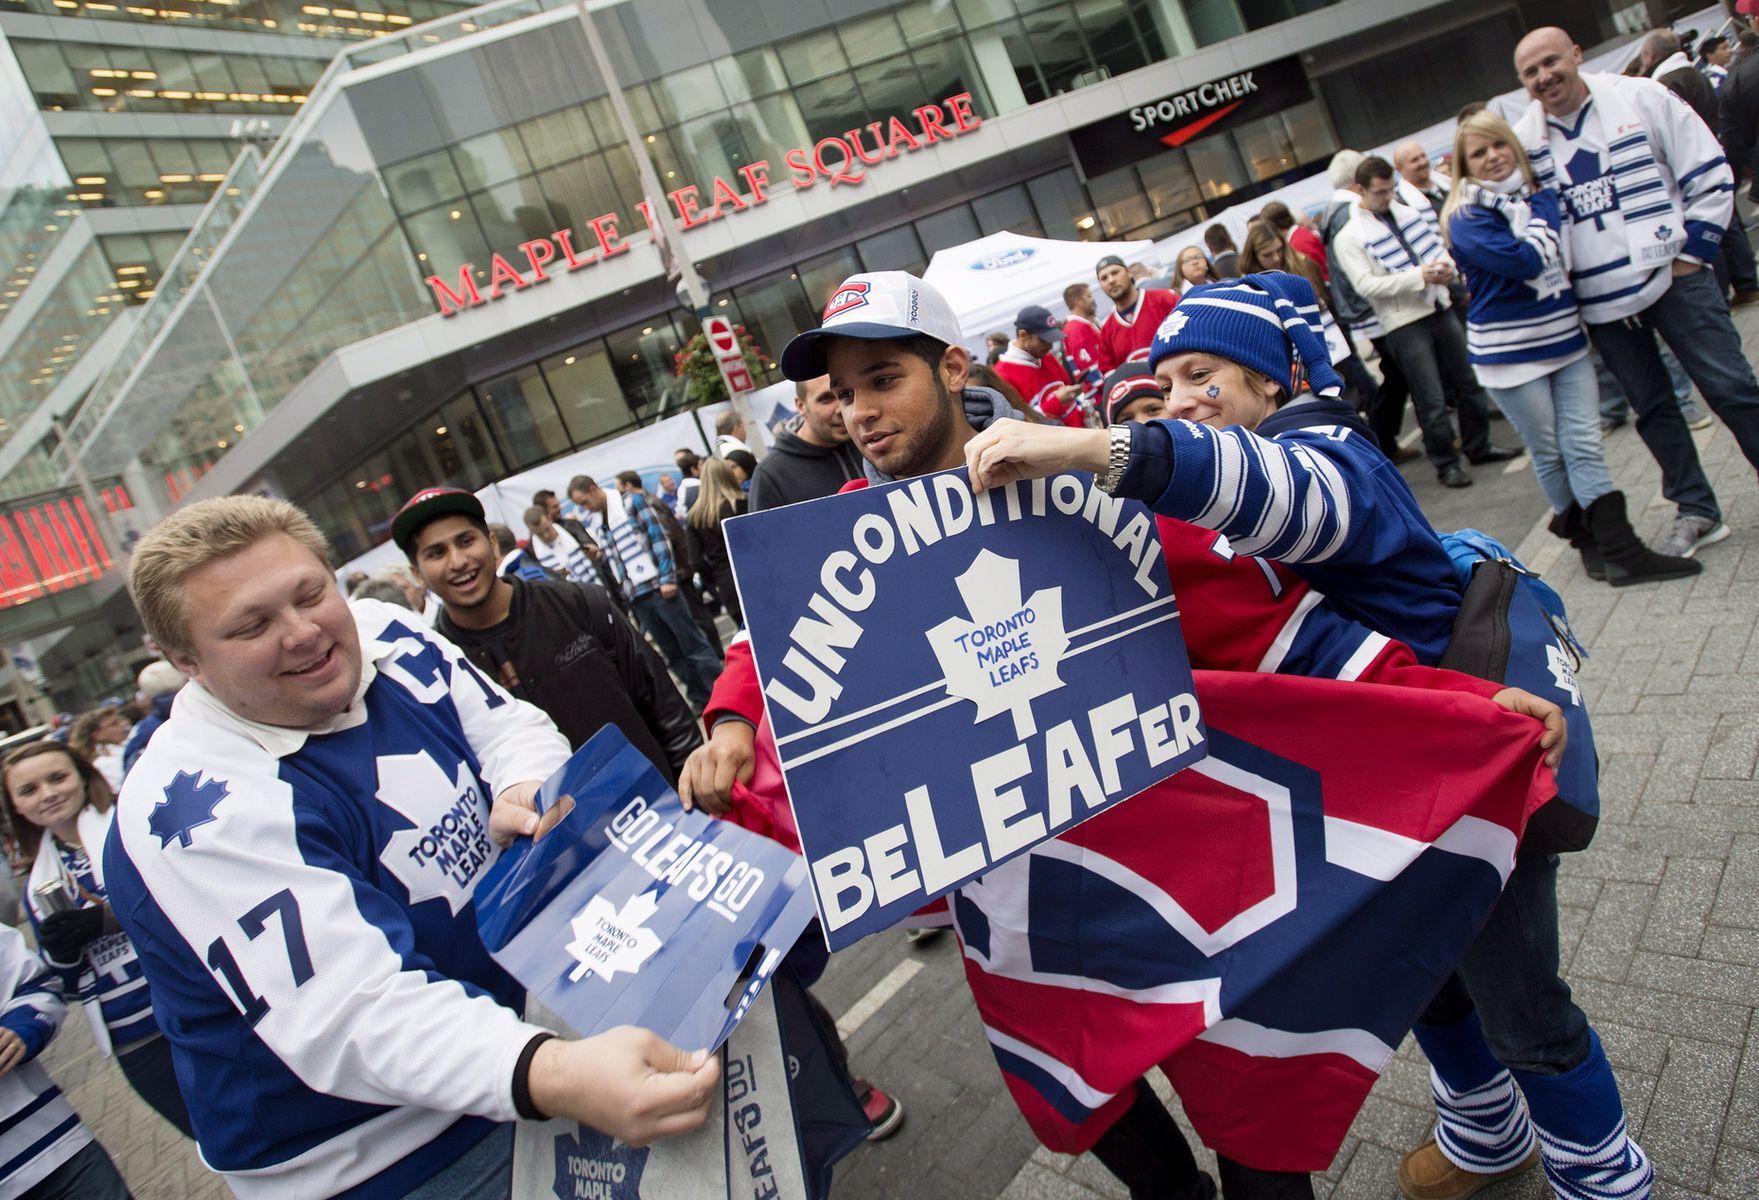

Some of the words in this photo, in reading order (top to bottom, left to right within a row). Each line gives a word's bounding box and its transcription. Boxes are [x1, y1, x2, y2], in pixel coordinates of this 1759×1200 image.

[1129, 71, 1258, 132] SPORTCHEK
[425, 212, 631, 317] MAPLE
[785, 91, 983, 189] SQUARE
[1562, 174, 1616, 201] TORONTO
[1573, 185, 1613, 209] MAPLE
[1578, 198, 1613, 217] LEAFS
[953, 607, 1036, 653] TORONTO
[976, 632, 1032, 669] MAPLE
[989, 651, 1040, 688] LEAFS
[408, 786, 477, 868] TORONTO
[612, 795, 660, 845] GO
[436, 812, 483, 876] MAPLE
[452, 833, 491, 889] LEAFS
[631, 822, 734, 902] LEAFS
[713, 861, 765, 913] GO
[585, 944, 610, 963] LEAFS
[592, 933, 621, 953] MAPLE
[595, 917, 638, 949] TORONTO
[207, 888, 315, 1029] 17
[567, 1155, 626, 1183] TORONTO
[733, 1102, 781, 1200] EAFS
[575, 1178, 613, 1200] MAPLE
